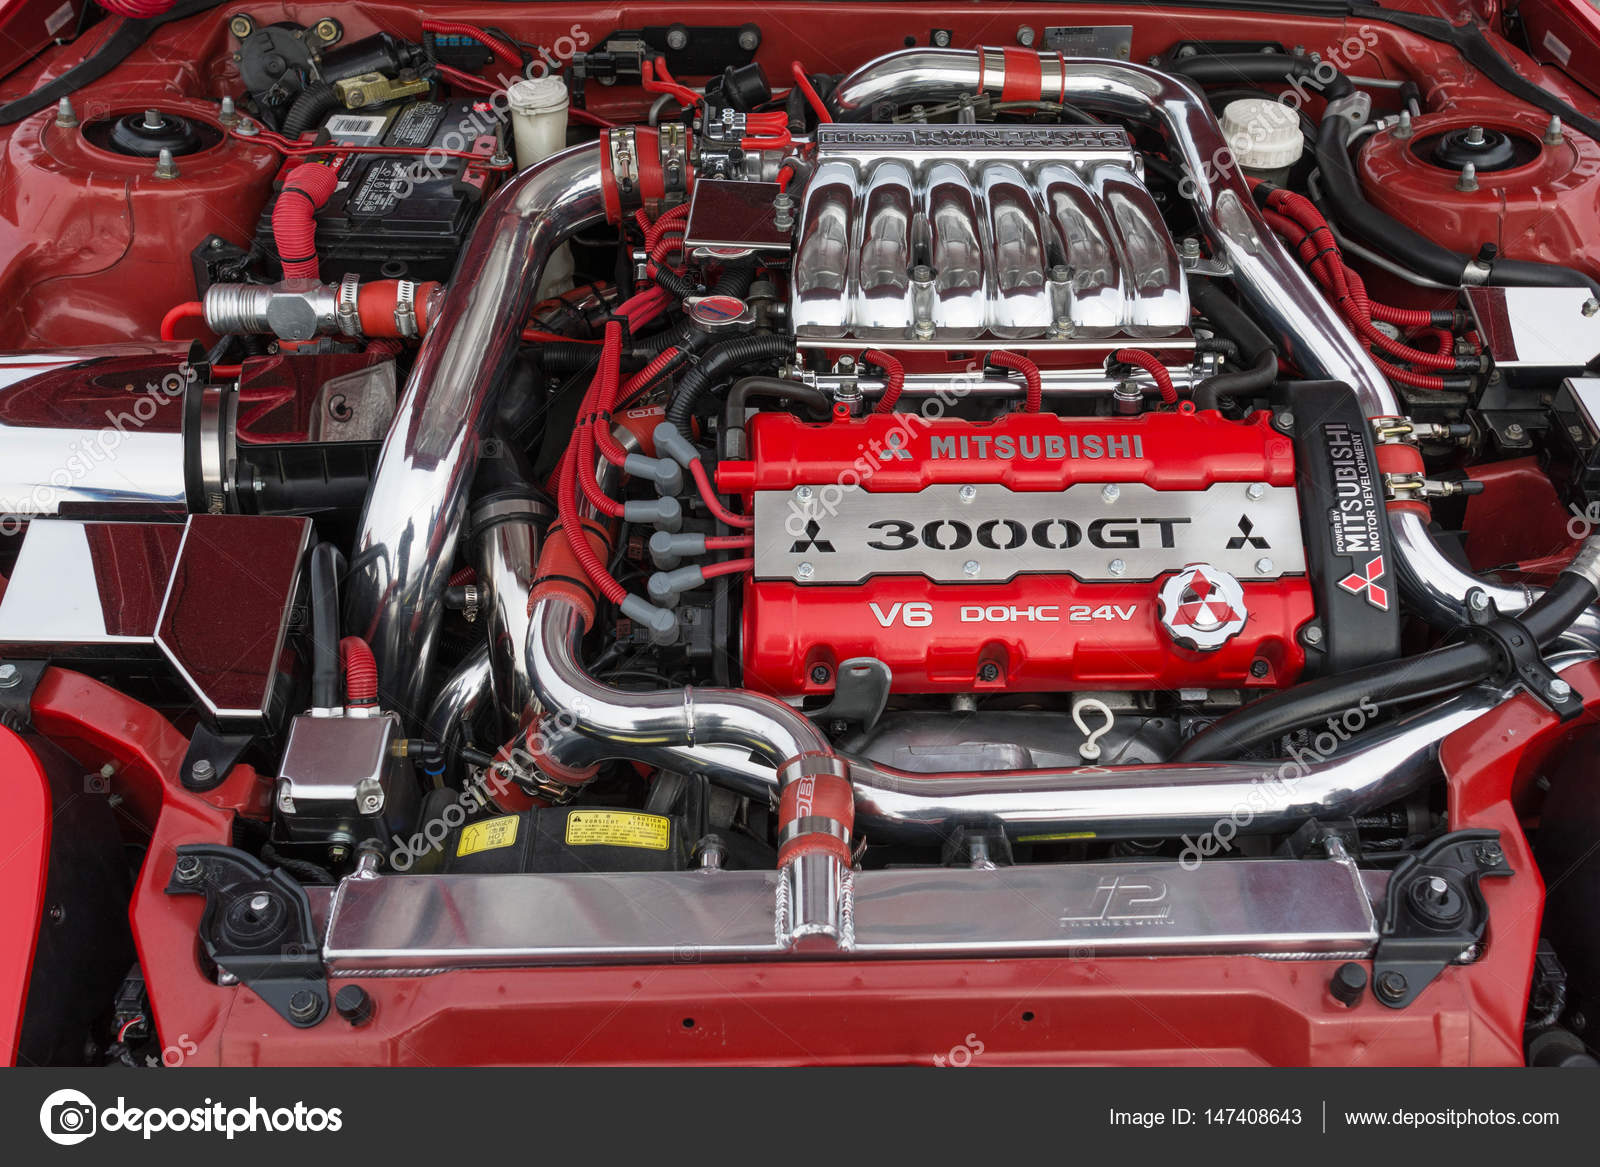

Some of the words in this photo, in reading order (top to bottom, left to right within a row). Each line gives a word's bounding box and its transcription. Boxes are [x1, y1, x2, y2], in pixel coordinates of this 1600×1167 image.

[930, 434, 1144, 460] MITSUBISHI
[1351, 433, 1374, 506] DEVELOPMENT
[1325, 424, 1369, 552] MITSUBISHI
[1332, 510, 1341, 521] BY
[1366, 510, 1381, 551] MOTOR
[867, 517, 1192, 550] 3000GT
[1334, 522, 1345, 552] POWER
[868, 602, 934, 628] V6
[960, 605, 1060, 622] DOHC
[1069, 605, 1137, 621] 24V
